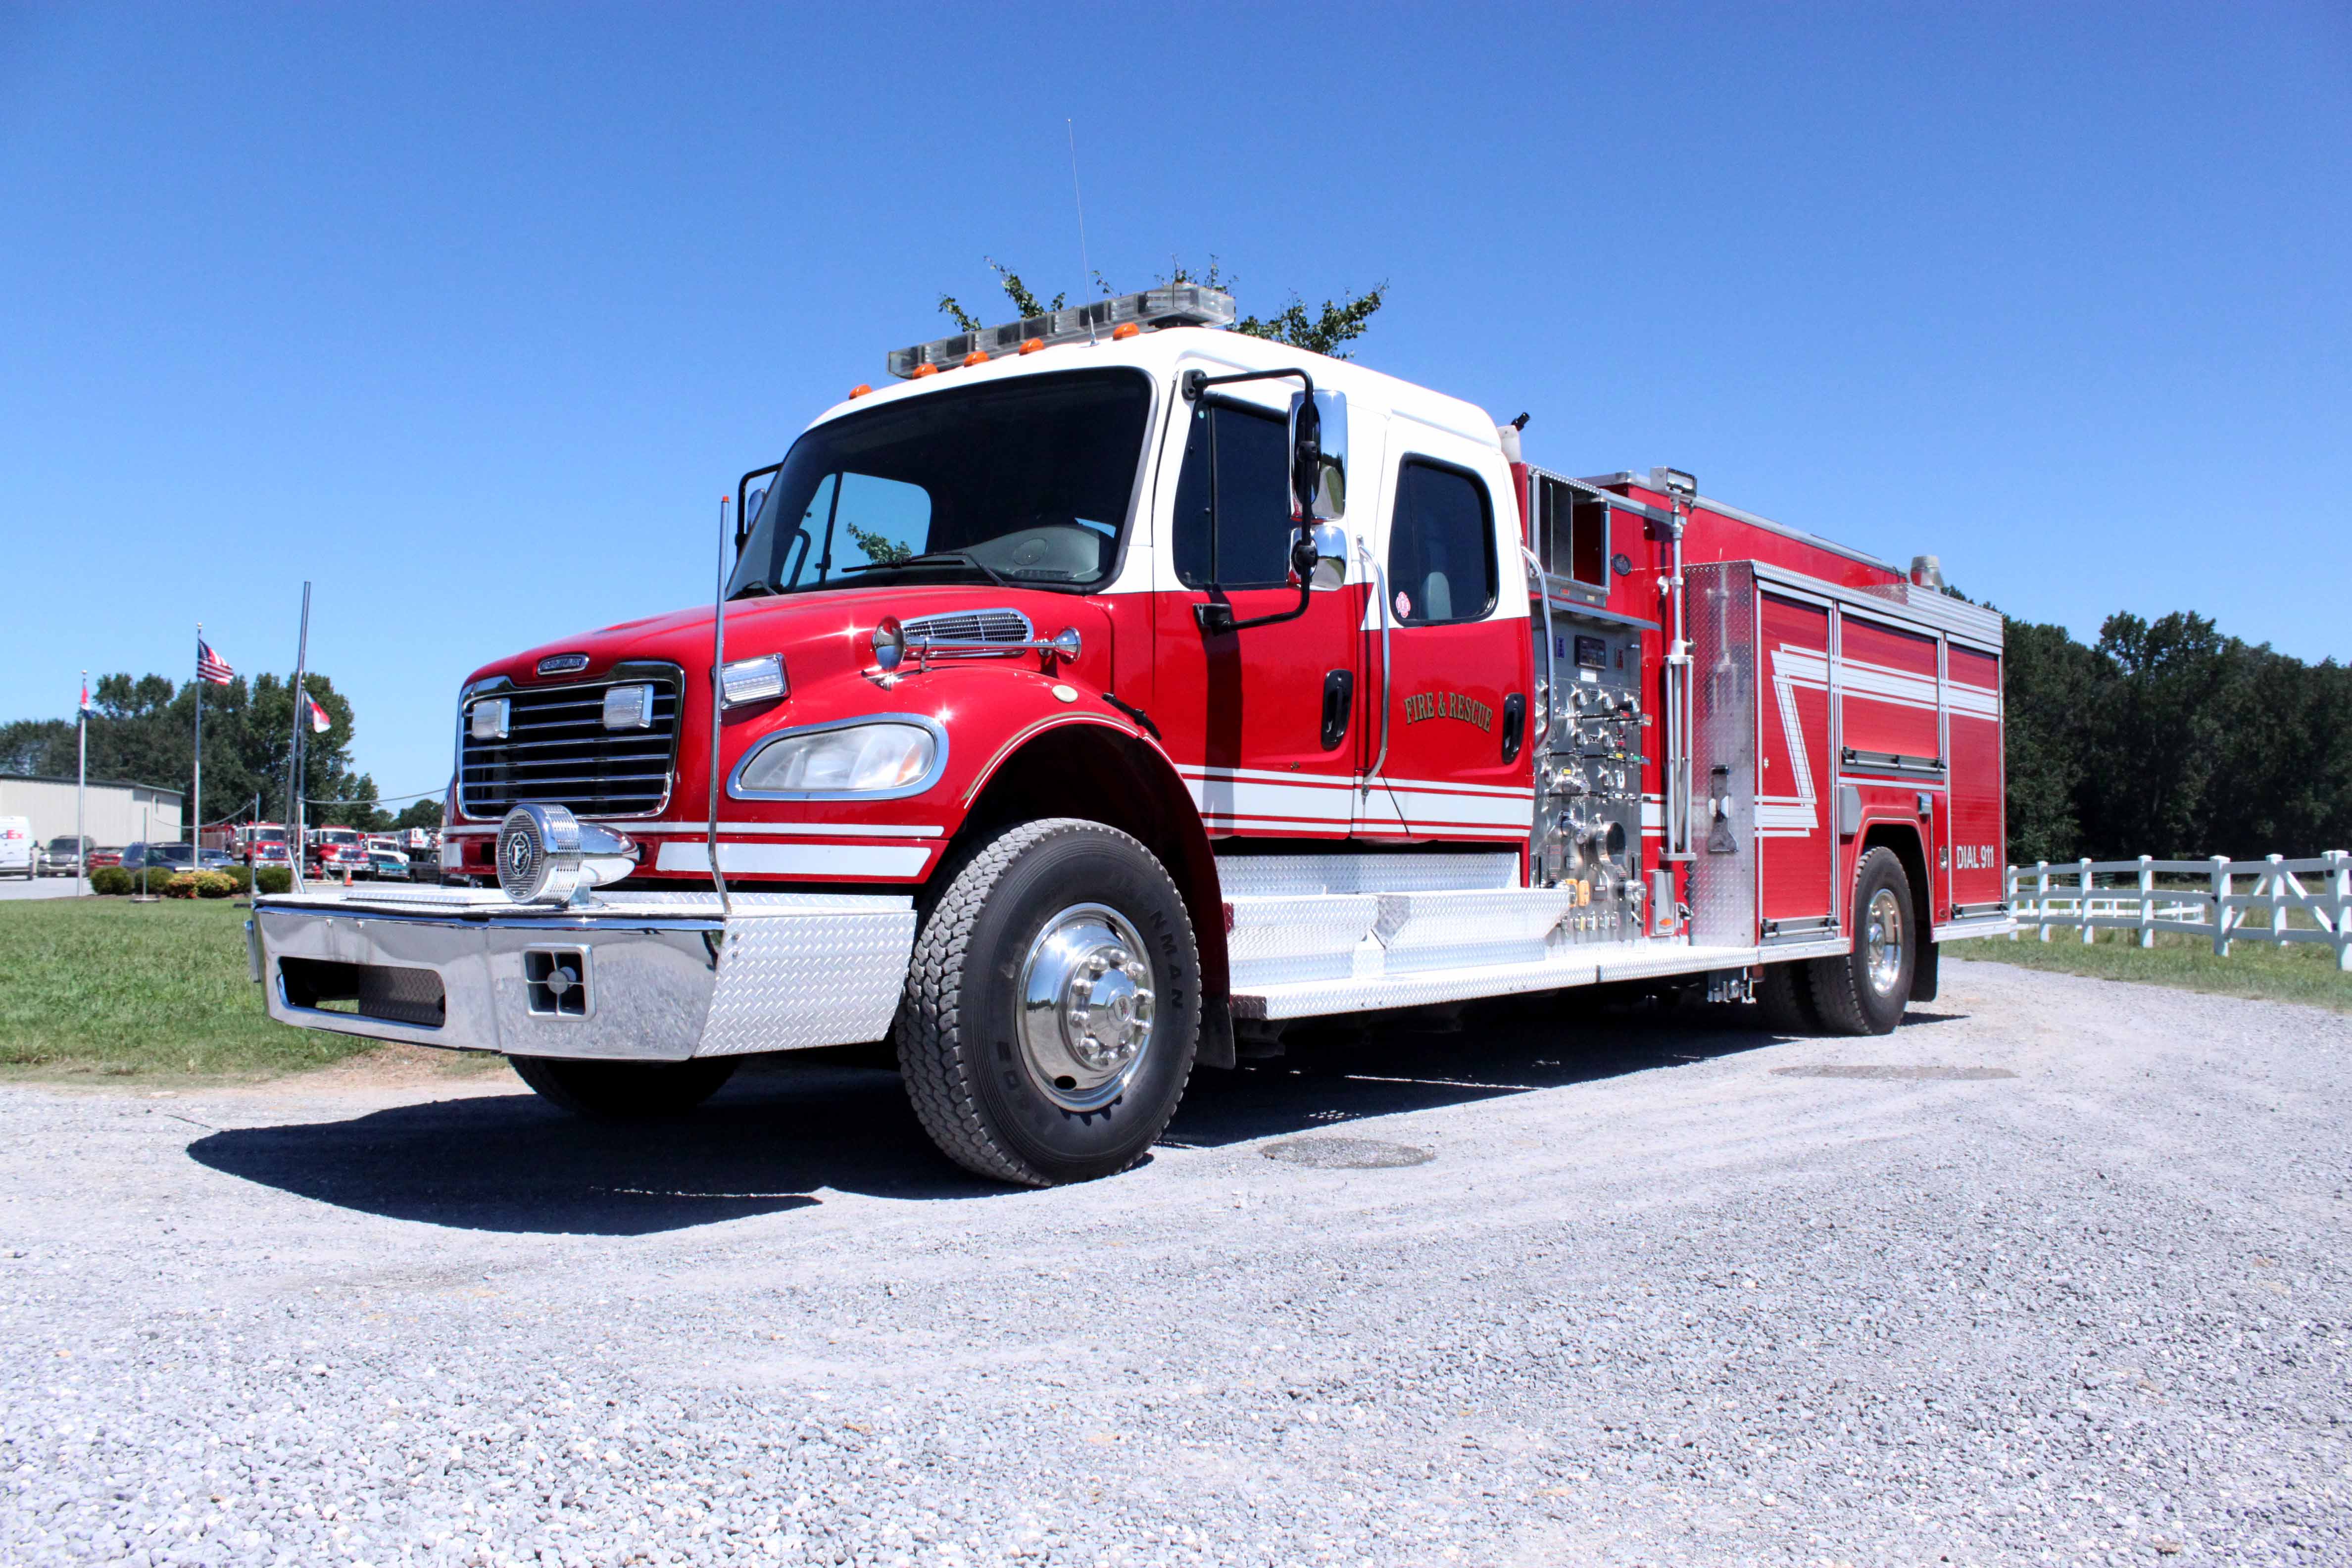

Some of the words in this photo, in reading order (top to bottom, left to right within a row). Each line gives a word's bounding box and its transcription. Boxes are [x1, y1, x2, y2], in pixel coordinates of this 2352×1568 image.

[1404, 692, 1434, 725] FIRE
[1438, 691, 1446, 717] &
[1449, 692, 1492, 733] RESCUE
[0, 829, 24, 840] dEx
[1957, 845, 1979, 869] DIAL
[1980, 845, 1994, 869] 911
